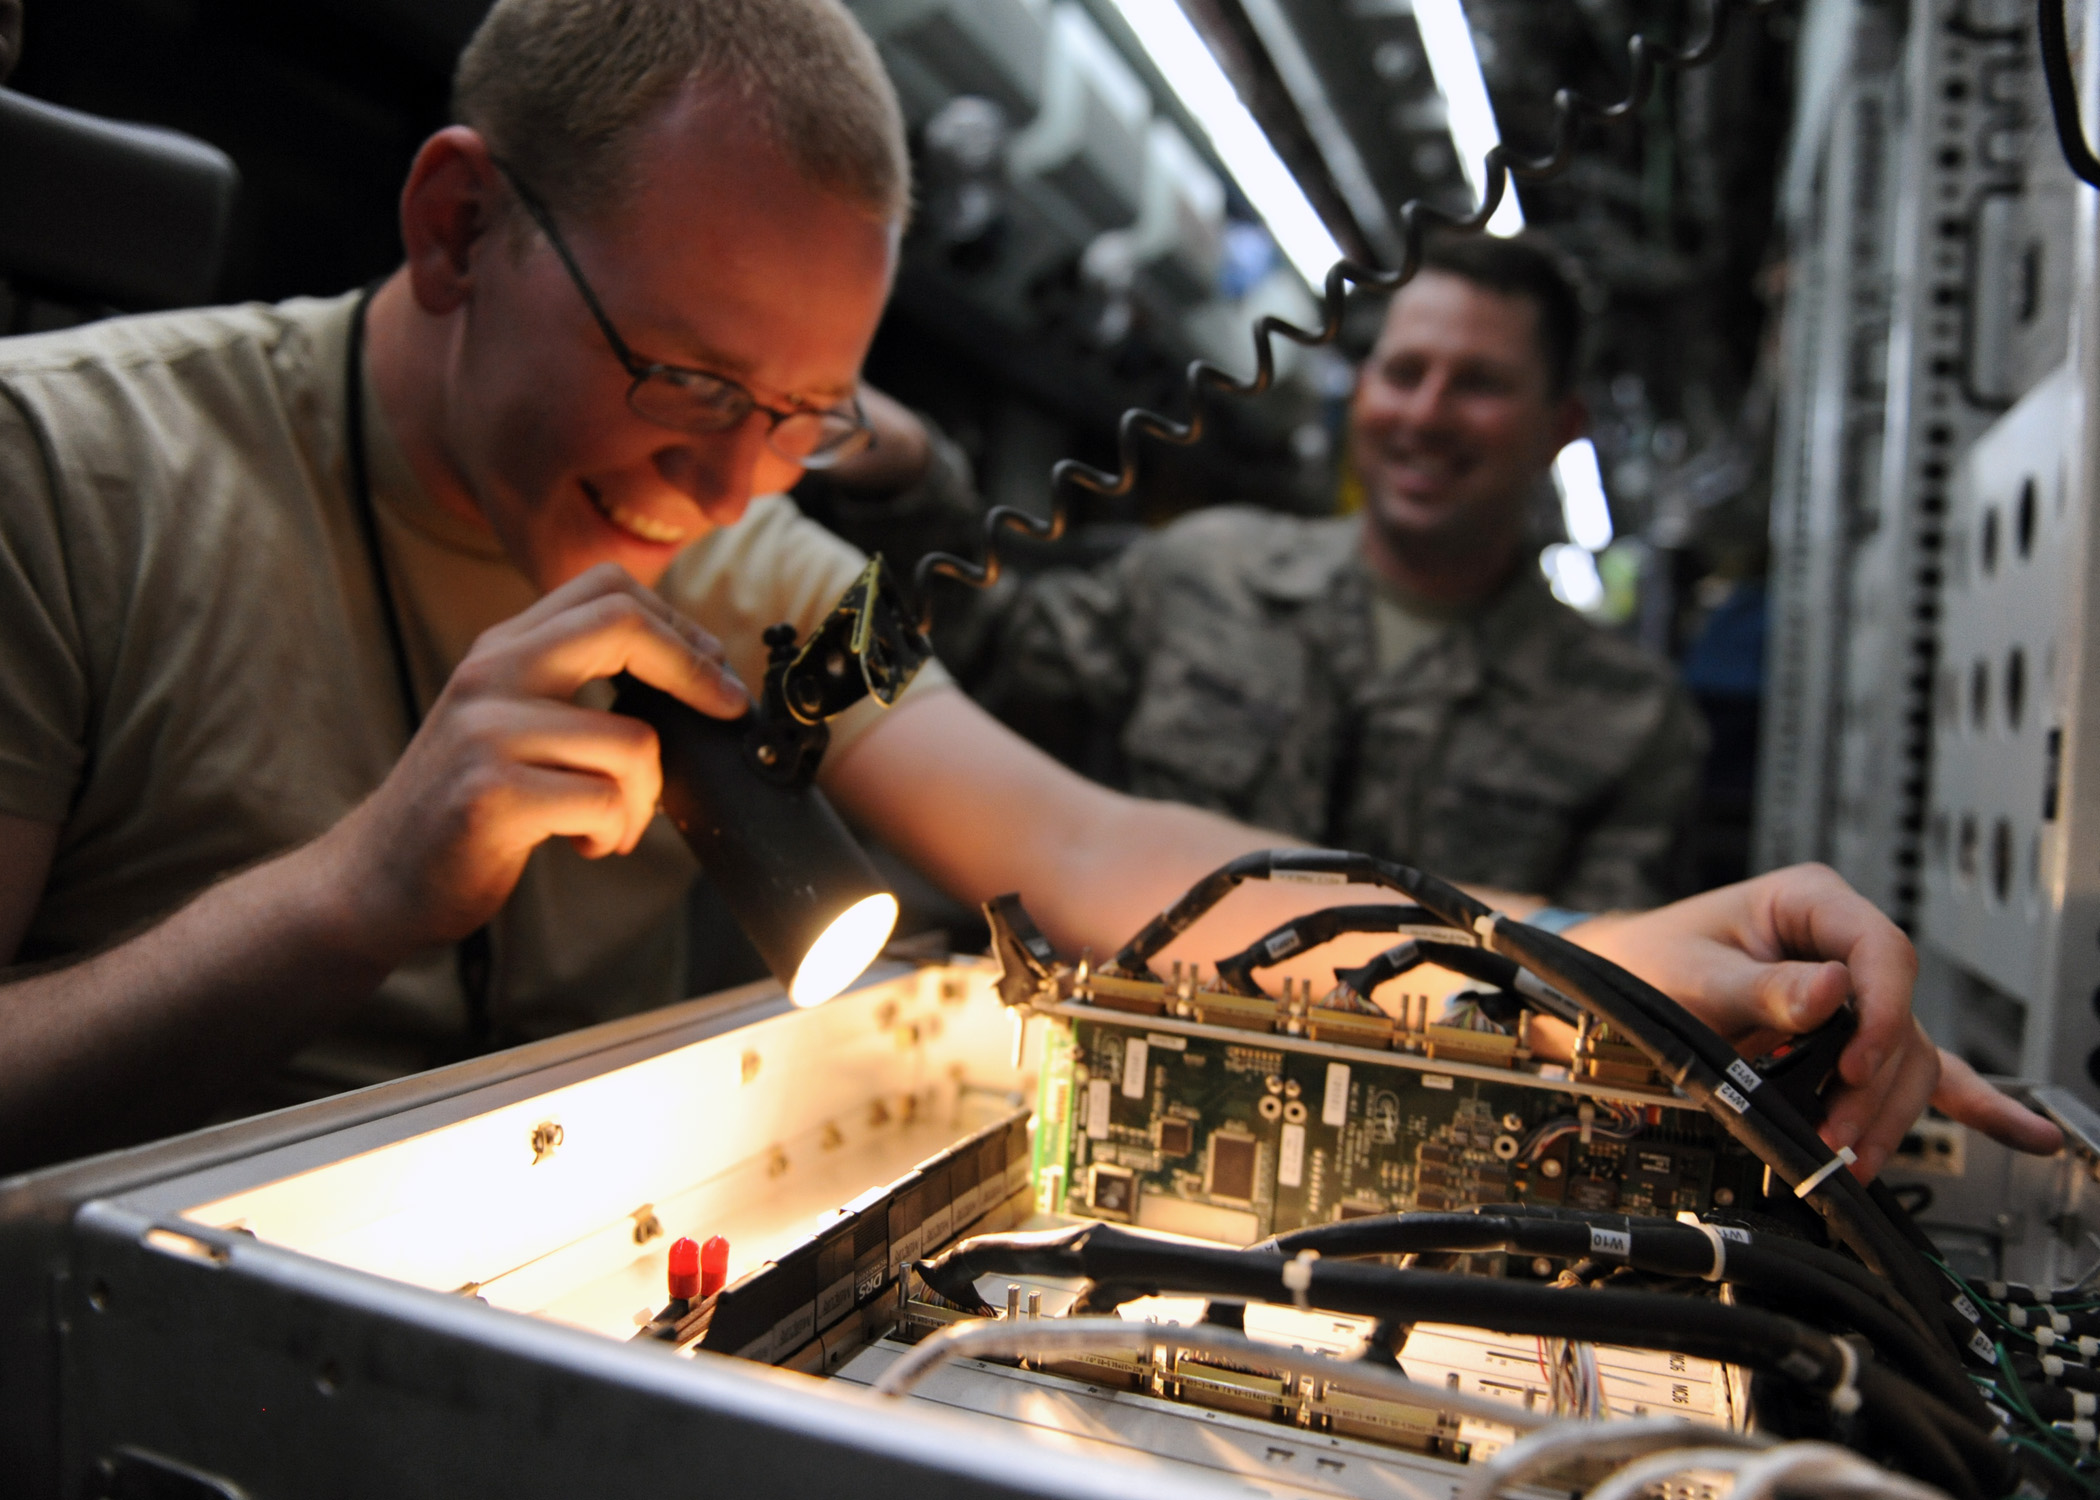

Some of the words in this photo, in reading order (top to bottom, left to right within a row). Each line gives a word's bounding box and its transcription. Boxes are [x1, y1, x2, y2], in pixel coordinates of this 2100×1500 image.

[1731, 1063, 1755, 1087] W13
[1721, 1085, 1746, 1108] W12
[1594, 1234, 1624, 1250] W10
[859, 1271, 883, 1300] DRS
[1672, 1384, 1689, 1404] MCJ6
